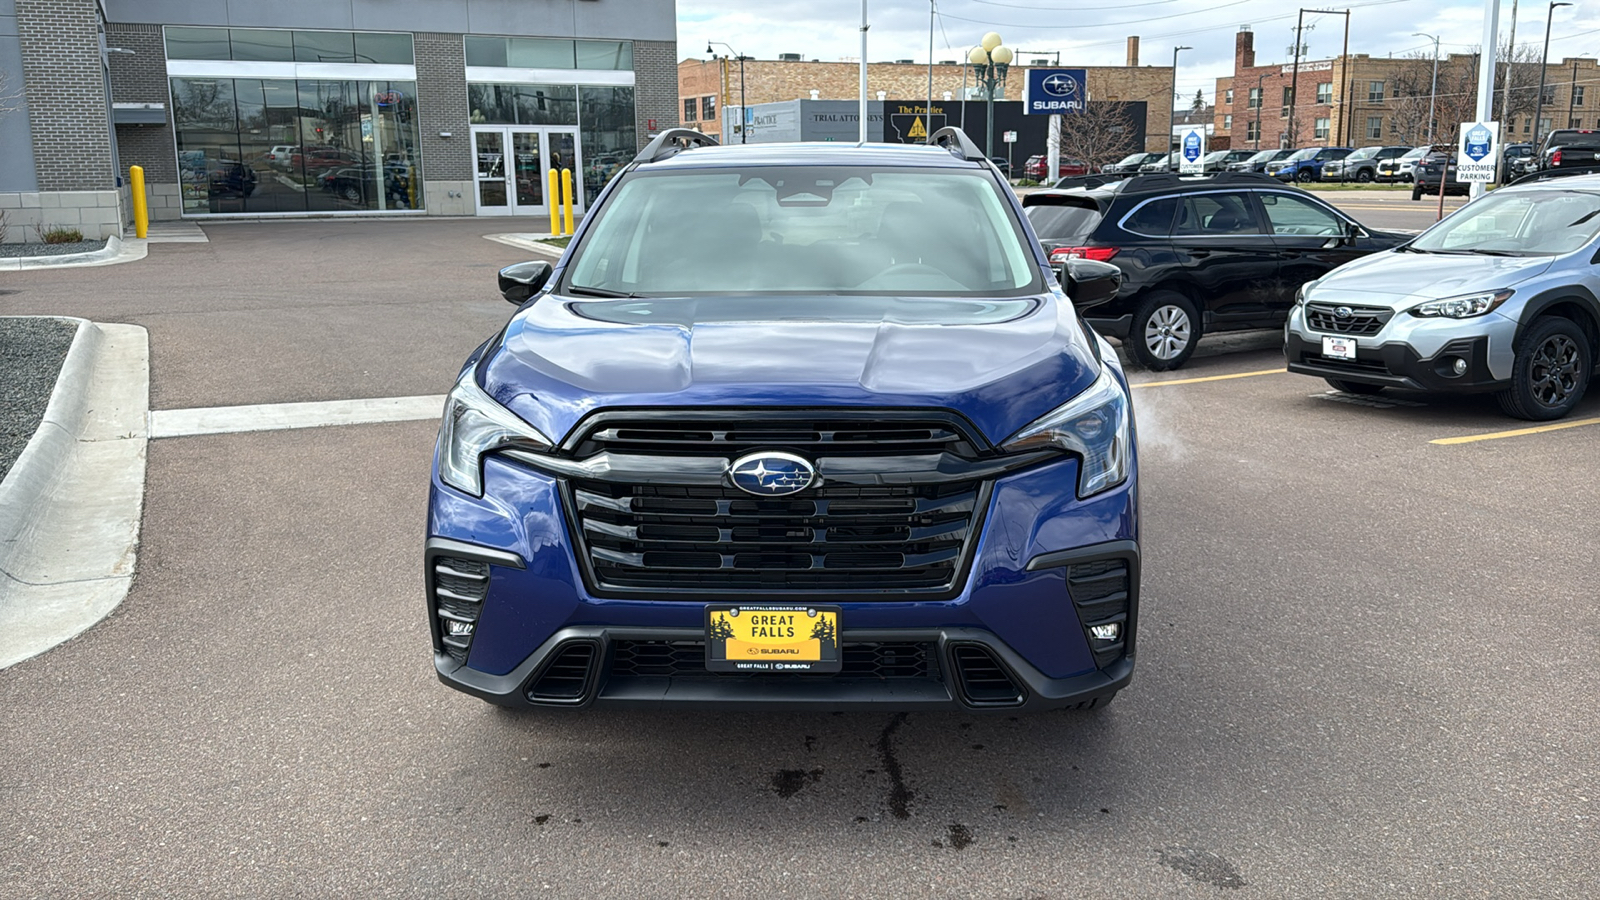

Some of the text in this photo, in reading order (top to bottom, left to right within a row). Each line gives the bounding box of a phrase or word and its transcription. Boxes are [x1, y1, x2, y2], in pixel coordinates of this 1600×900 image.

[374, 92, 400, 103] OPEN
[898, 105, 943, 114] The Pratice
[1033, 100, 1082, 110] SUBARU
[754, 115, 777, 125] PRACTICE
[813, 114, 884, 122] TRIAL ATTOEYS
[751, 616, 794, 625] GREAT
[752, 627, 794, 637] FALLS
